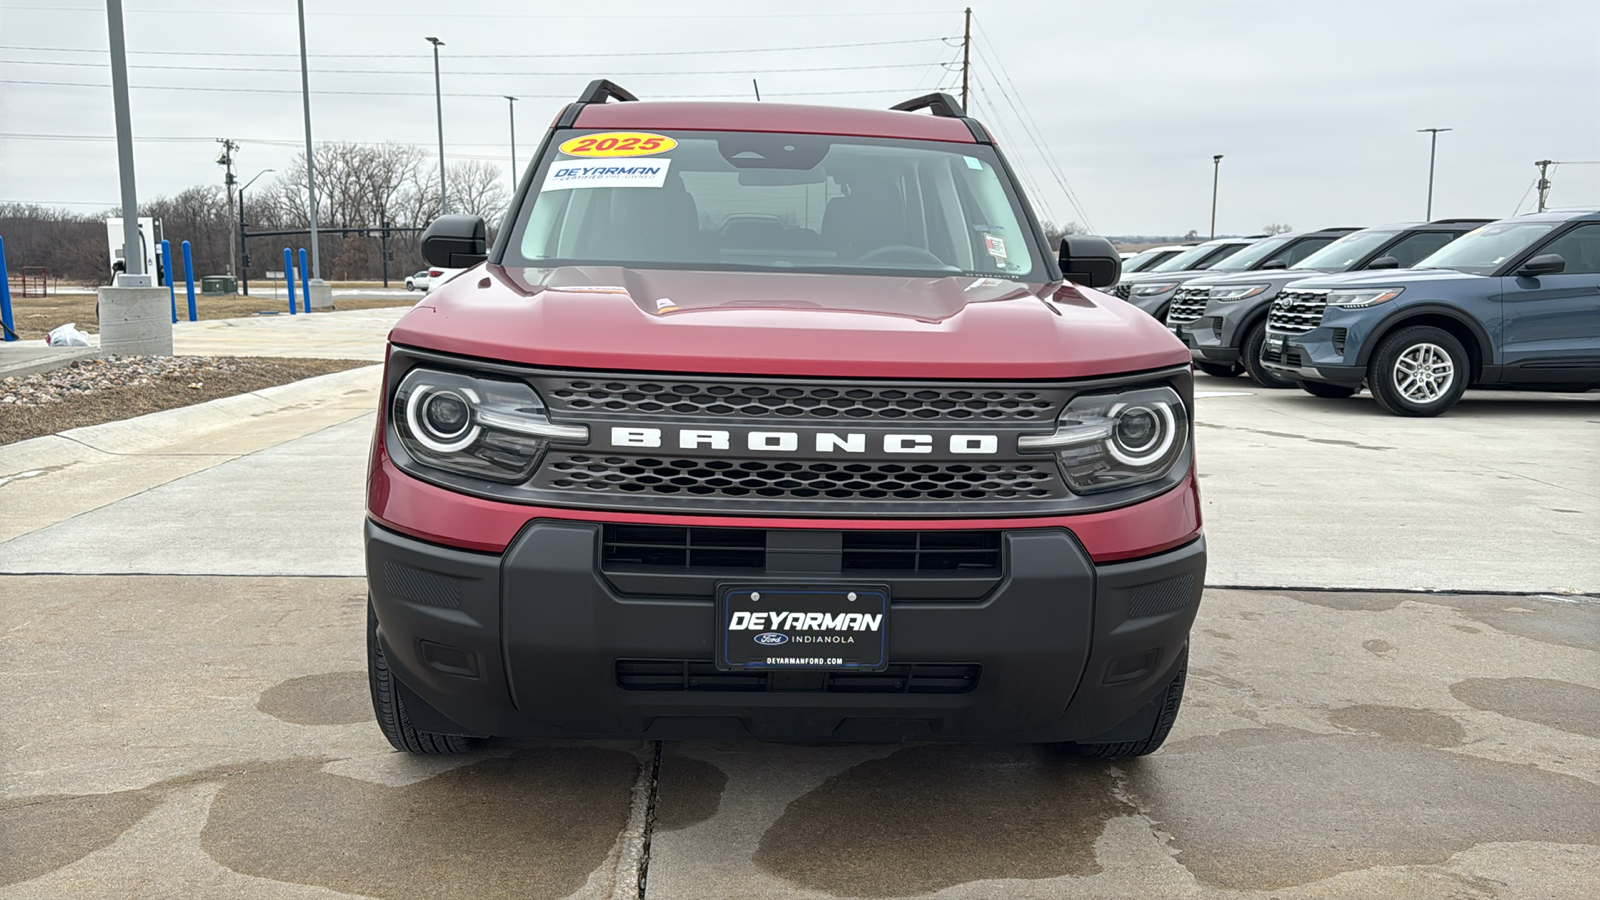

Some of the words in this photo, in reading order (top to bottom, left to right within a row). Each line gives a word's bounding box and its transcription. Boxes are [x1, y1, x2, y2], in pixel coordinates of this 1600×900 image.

[570, 138, 665, 153] 2025
[554, 167, 661, 178] DEYARMAN
[611, 427, 998, 454] BRONCO
[728, 611, 883, 631] DEYARMAN
[760, 633, 782, 644] Ford
[791, 635, 855, 644] INDIANOLA
[766, 657, 843, 665] DEYARMANFORD.COM
